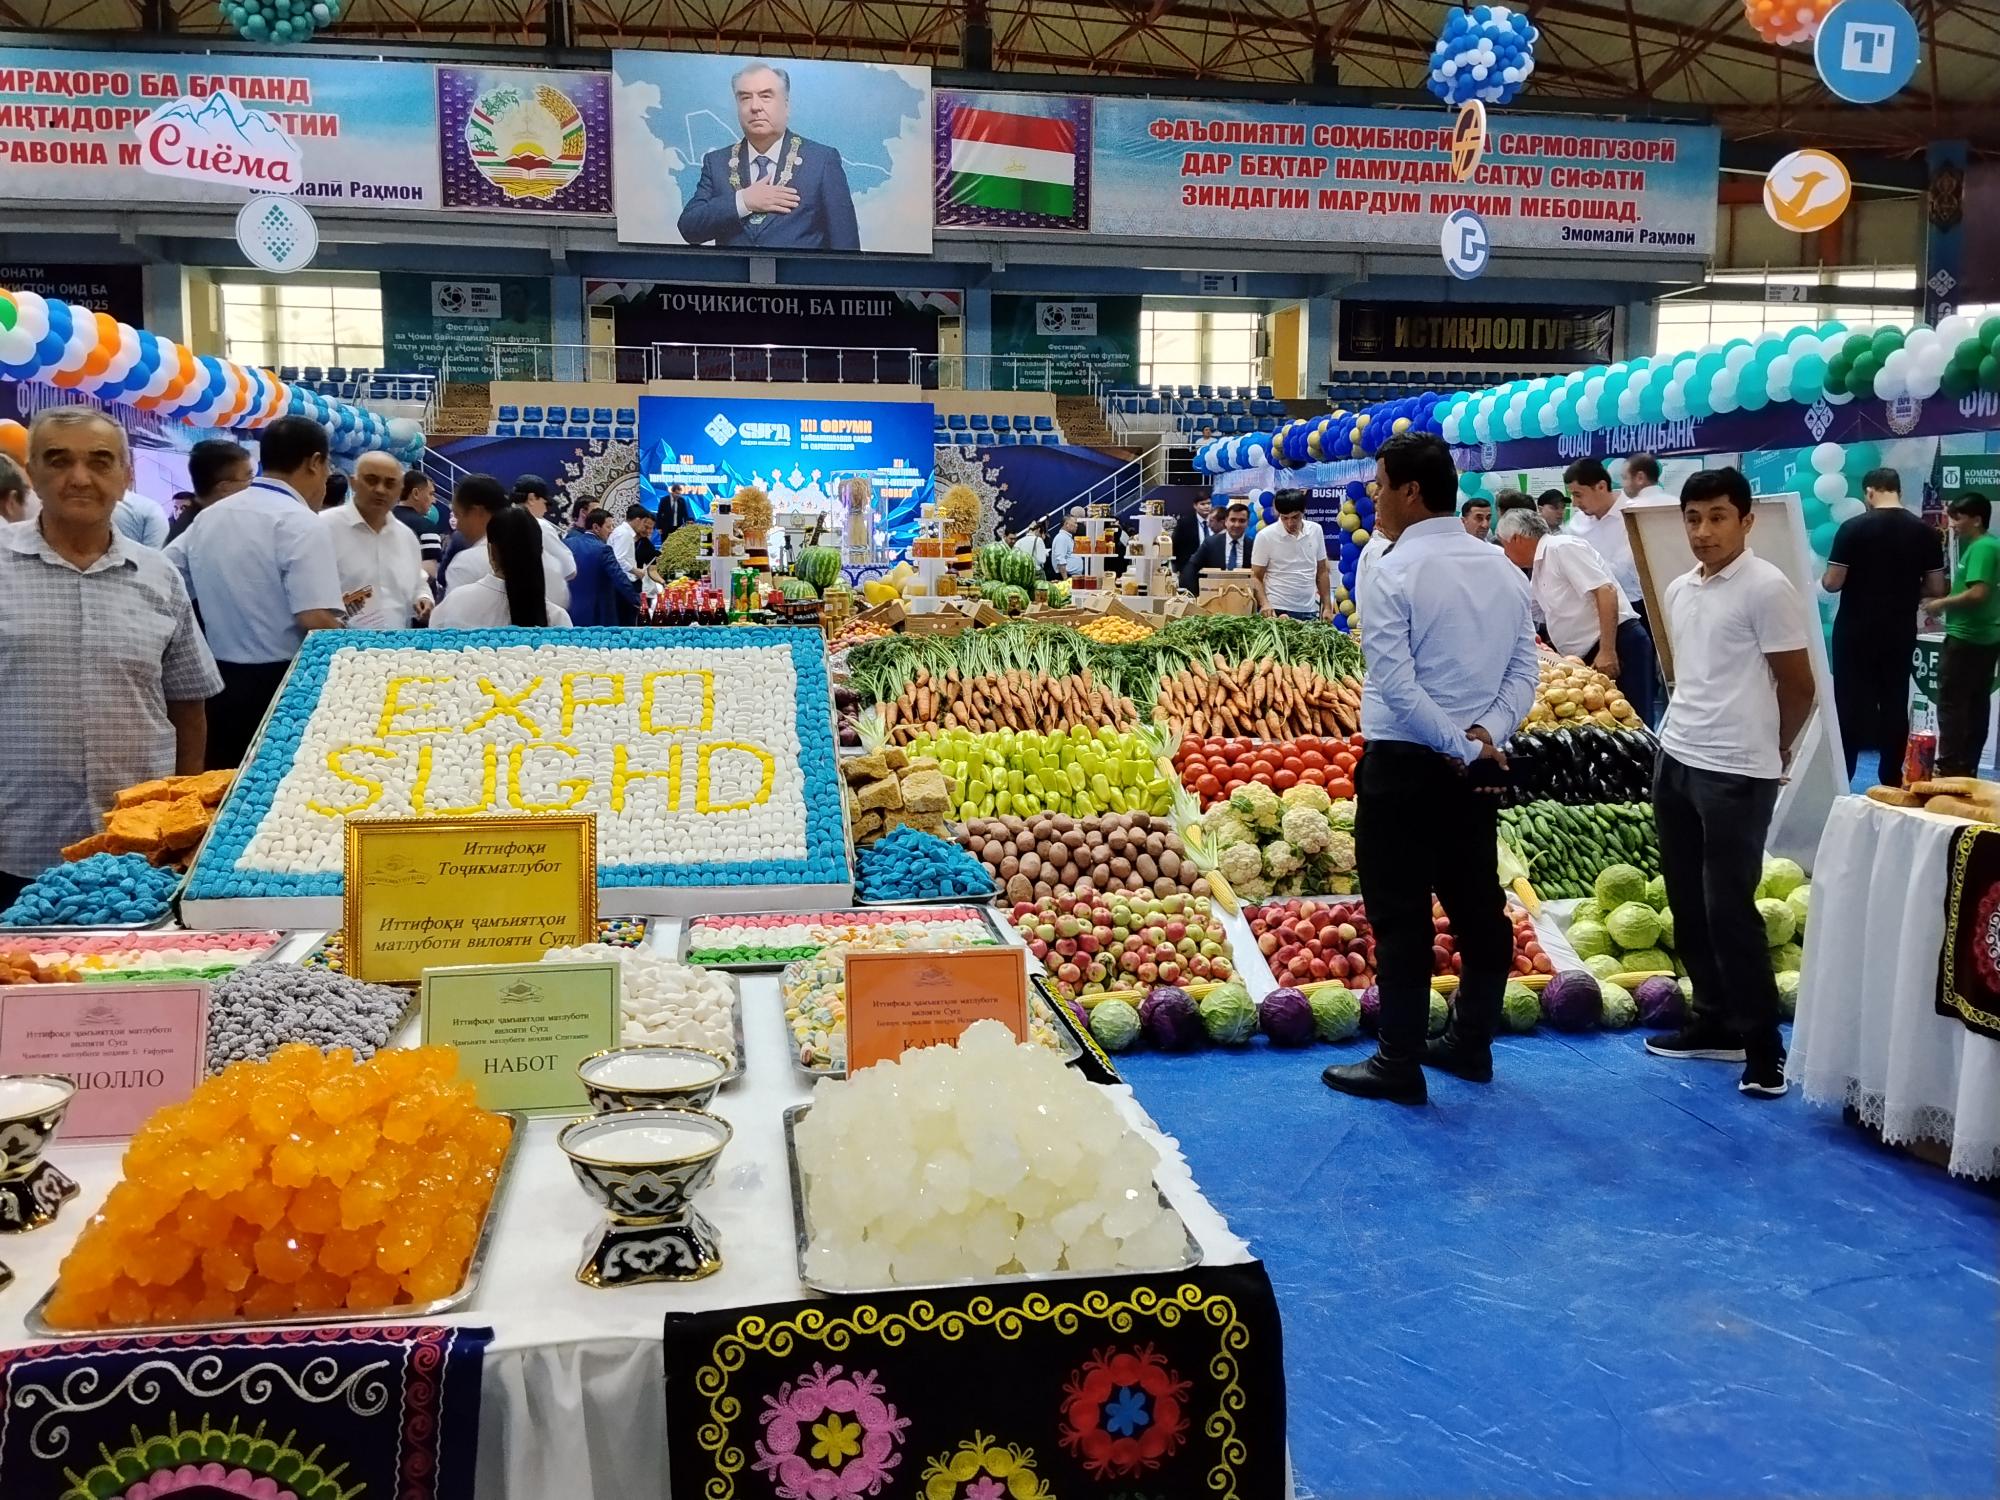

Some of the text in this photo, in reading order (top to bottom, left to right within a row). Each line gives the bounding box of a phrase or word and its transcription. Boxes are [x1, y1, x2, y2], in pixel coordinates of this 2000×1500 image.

[141, 74, 179, 97] БА
[1150, 119, 1305, 146] ФАЪОЛИЯТИ
[1500, 133, 1676, 161] САРМОЯГУЗОРӢ
[150, 122, 292, 183] Сиёма
[1181, 153, 1232, 176] ДАР
[1240, 155, 1327, 179] БЕҲТАР
[1474, 165, 1543, 189] САТҲУ
[1551, 166, 1644, 191] СИФАТИ
[350, 181, 423, 201] Раҳмон
[1182, 185, 1309, 210] ЗИНДАГИИ
[1318, 189, 1421, 215] МАРДУМ
[1520, 197, 1641, 223] МЕБОШАД.
[1561, 226, 1696, 246] Эмомалӣ Раҳмон
[59, 284, 88, 296] ОИД
[91, 284, 108, 295] БА
[659, 293, 893, 318] ТОҶИКИСТОН, БА ПЕШ!
[1395, 316, 1526, 353] ИСТИҚЛОЛ
[377, 670, 715, 738] EXPO
[307, 741, 777, 817] SUGHD
[463, 841, 547, 857] Иттифоқи
[438, 861, 562, 878] Тоҷикматлубот
[378, 914, 567, 934] Иттифоқи ҷамъиятҳои
[374, 931, 577, 954] матлуботи вилояти Суғд
[484, 1054, 559, 1075] НАБОТ
